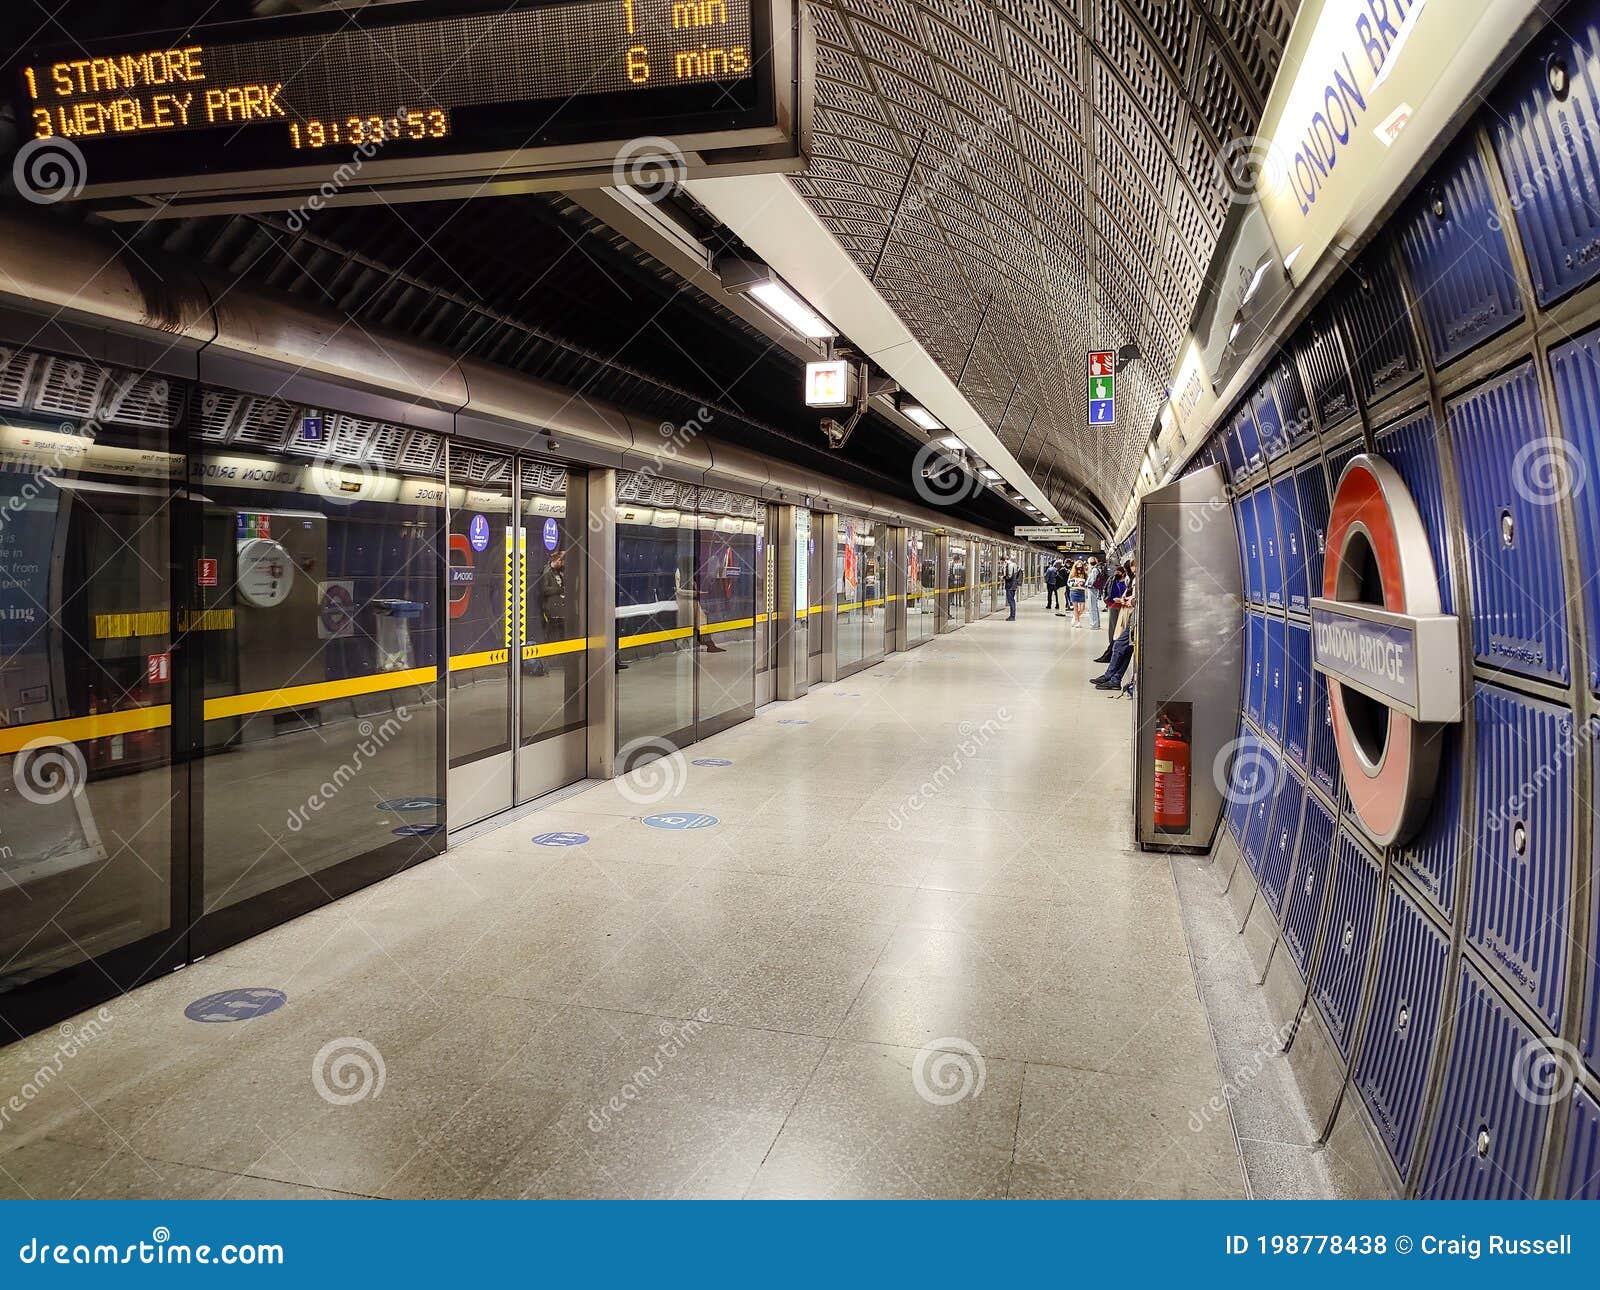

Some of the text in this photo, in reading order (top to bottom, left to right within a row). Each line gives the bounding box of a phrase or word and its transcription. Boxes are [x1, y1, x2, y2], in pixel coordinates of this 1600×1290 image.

[24, 0, 727, 98] 1 STANMORE 1 min
[33, 43, 749, 139] 3 WEMBLEY PARK 6 mins
[290, 108, 447, 149] 19:33:53
[1288, 52, 1367, 217] LONDON
[1316, 622, 1405, 685] LONDON BRIDGE
